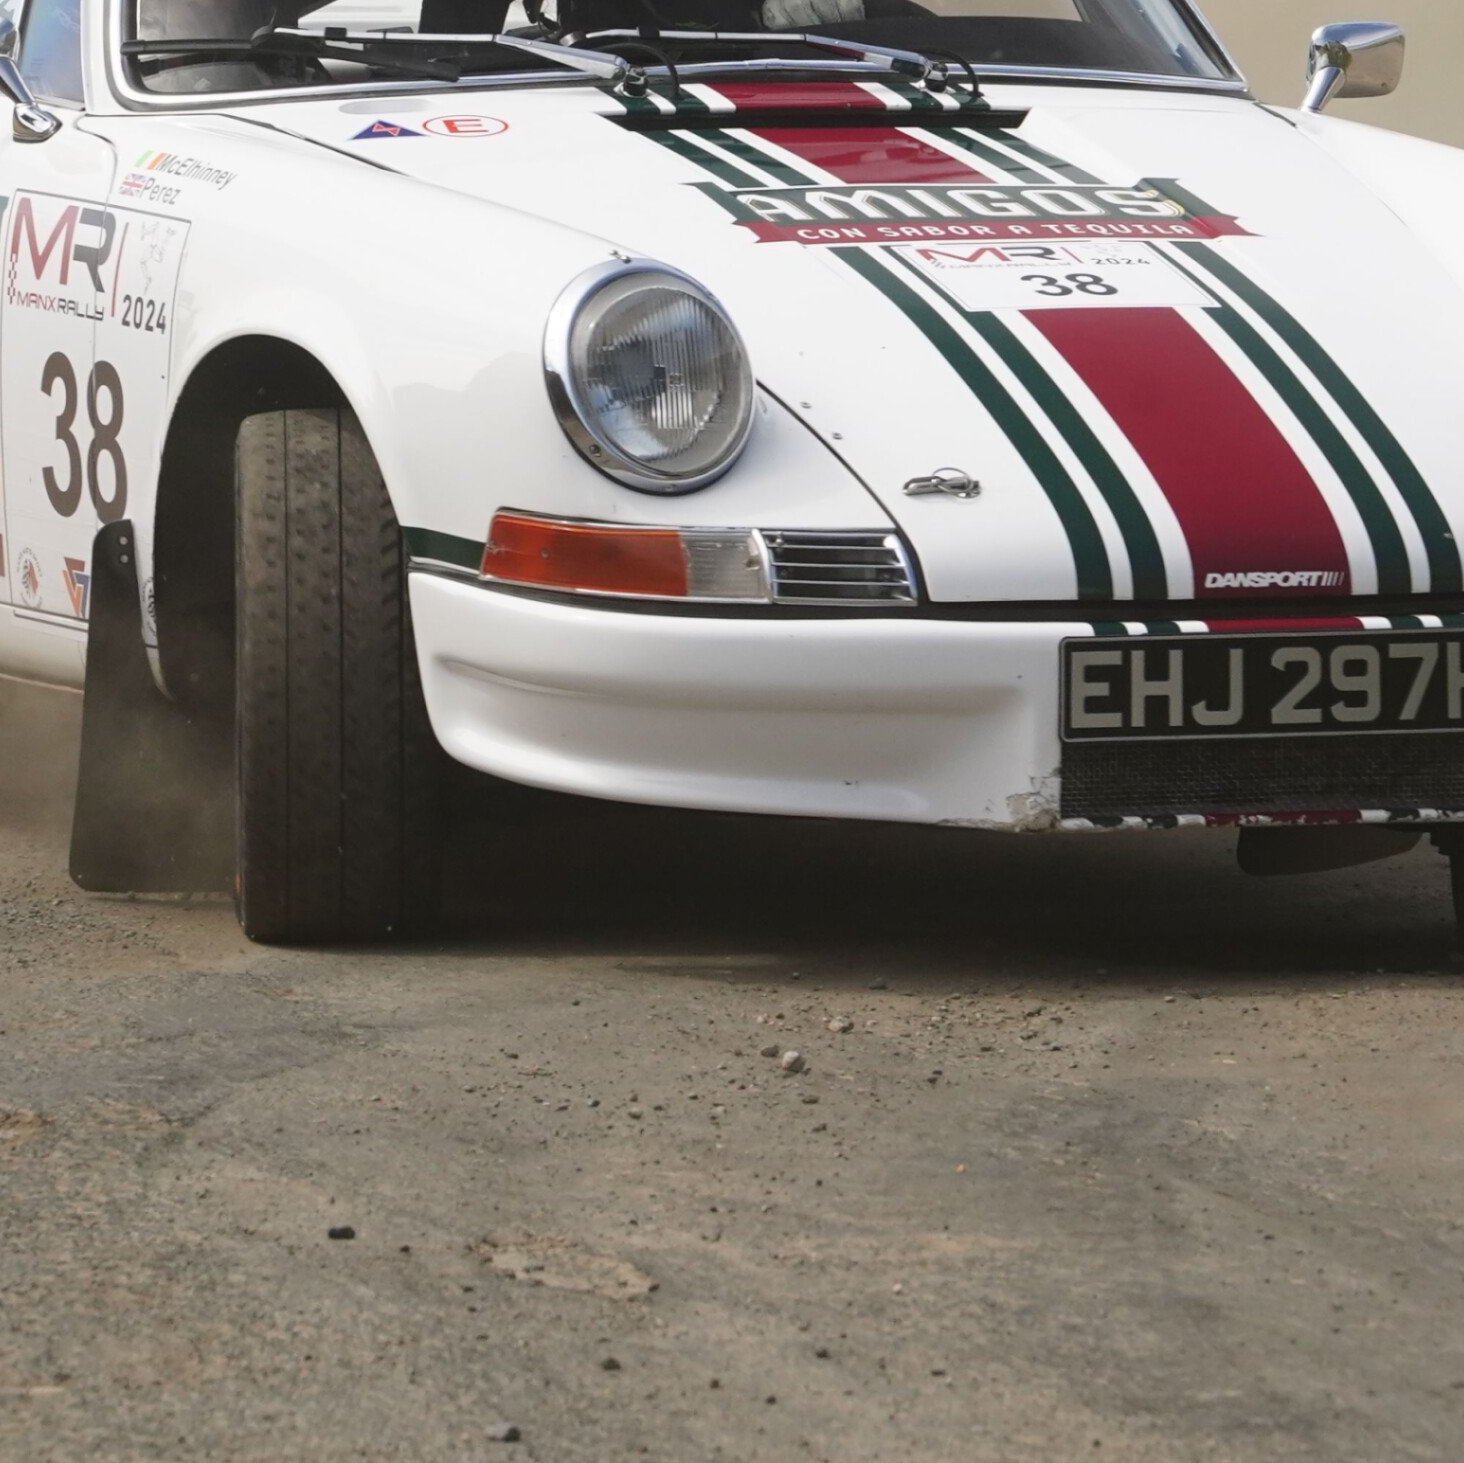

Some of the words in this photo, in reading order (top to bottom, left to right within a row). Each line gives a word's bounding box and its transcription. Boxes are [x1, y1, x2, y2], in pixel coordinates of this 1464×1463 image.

[443, 119, 490, 134] E
[156, 154, 237, 191] McElhinney
[138, 177, 182, 206] Perez
[736, 189, 1186, 222] AMIGOS
[797, 227, 866, 240] CON
[877, 225, 996, 238] SABOR
[1007, 224, 1032, 236] A
[1041, 223, 1195, 236] TEQUILA
[1091, 257, 1152, 266] 2024
[1020, 272, 1118, 297] 38
[121, 294, 166, 334] 2024
[40, 350, 128, 525] 38
[1204, 570, 1322, 589] DANSPORT
[1070, 648, 1245, 728] EHJ
